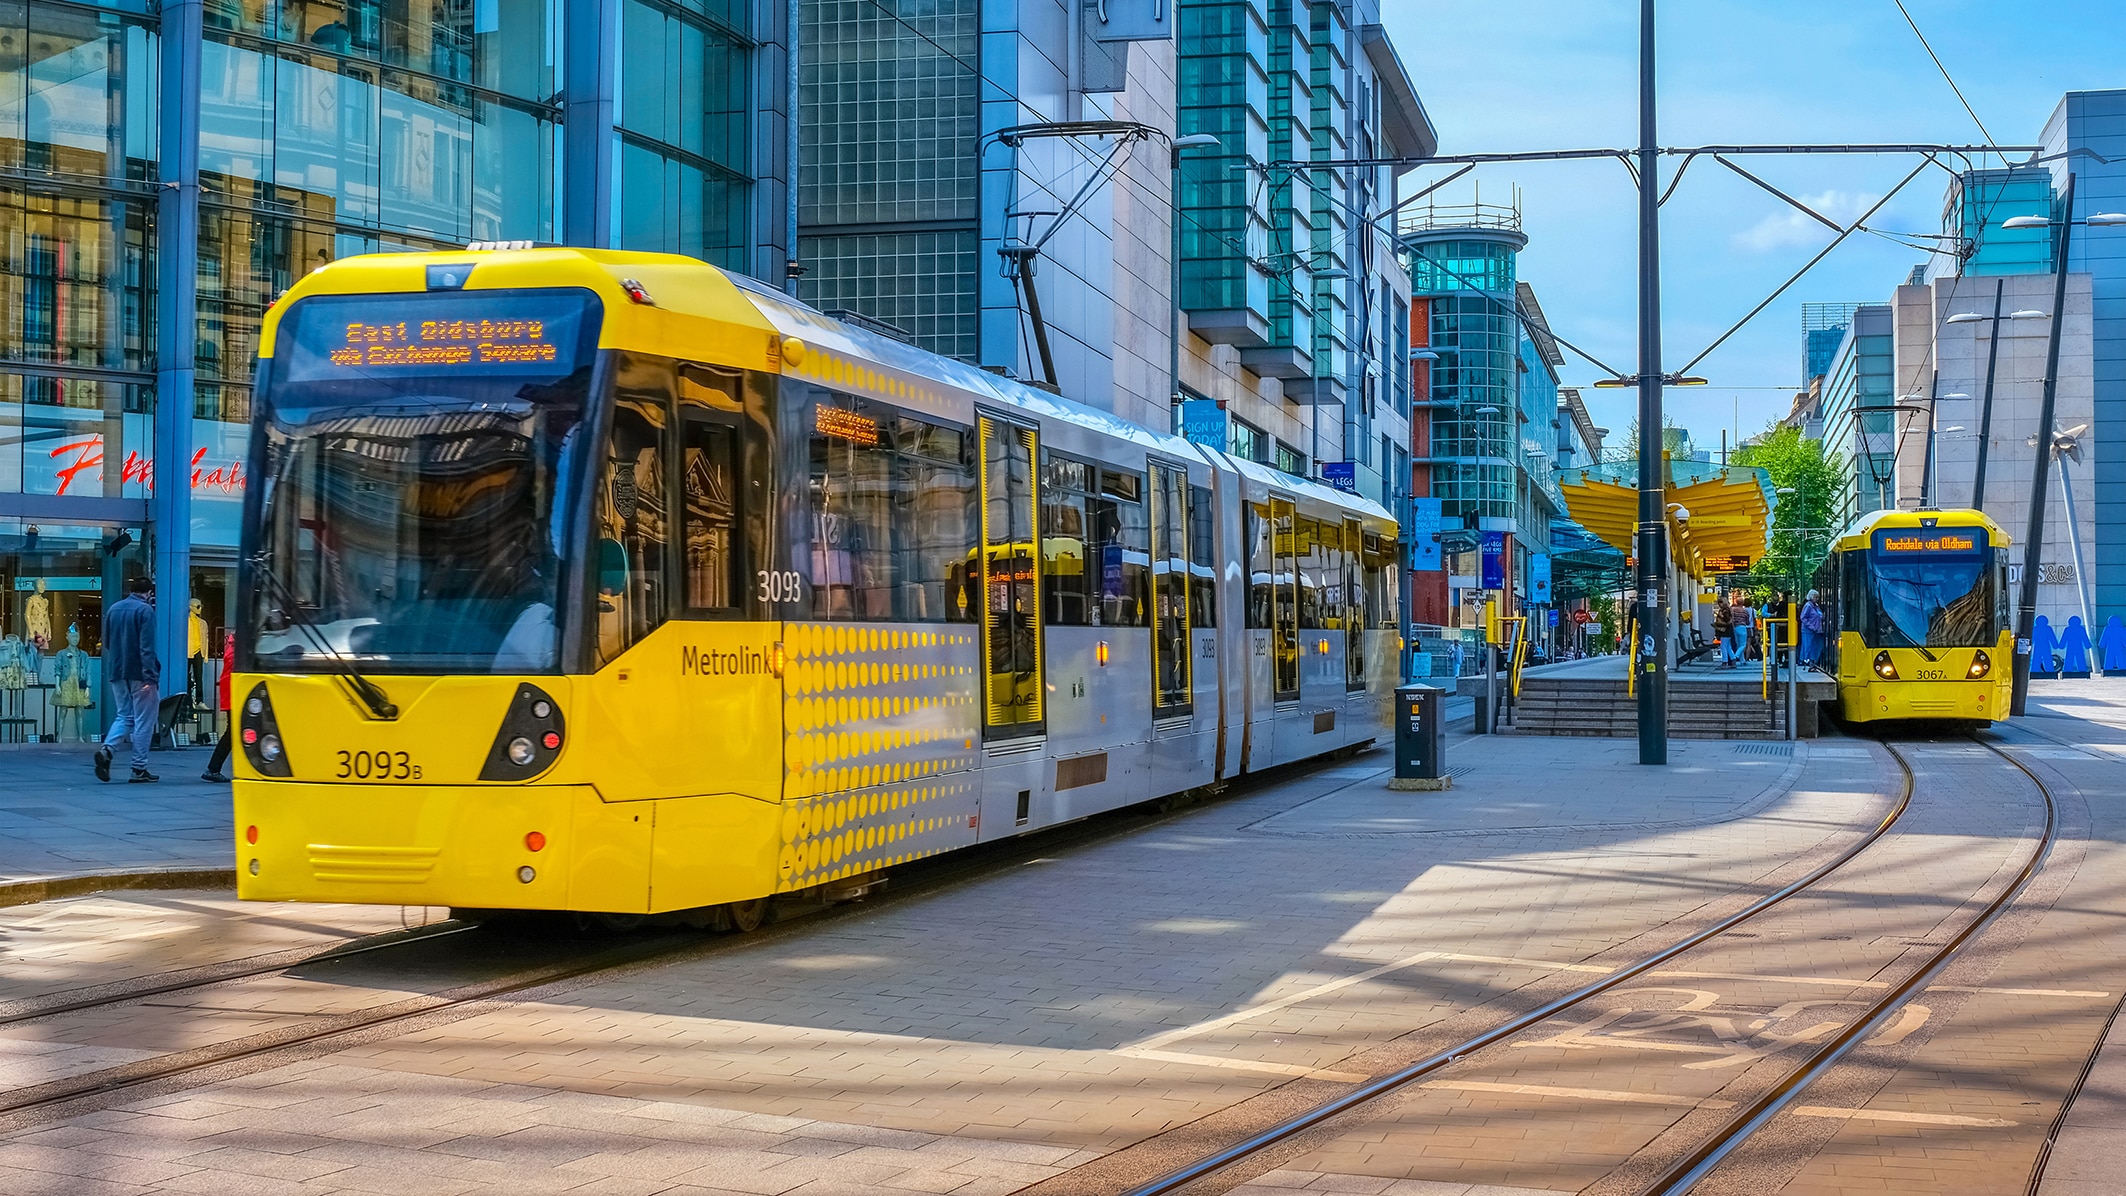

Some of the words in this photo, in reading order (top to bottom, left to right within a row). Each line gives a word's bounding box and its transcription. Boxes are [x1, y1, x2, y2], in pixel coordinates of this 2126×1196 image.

[346, 323, 407, 343] East
[420, 320, 543, 341] Didsbury
[330, 347, 362, 366] via
[367, 345, 472, 364] Exchange
[477, 343, 556, 362] Square
[1186, 421, 1209, 433] SIGN
[1210, 421, 1224, 433] UP
[1187, 432, 1224, 447] TODAY
[1336, 476, 1353, 486] LEGS
[1886, 537, 1923, 550] Rochdale
[1925, 538, 1939, 550] via
[1941, 536, 1973, 549] Oldham
[757, 570, 802, 603] 3093
[682, 645, 773, 676] Metrolink
